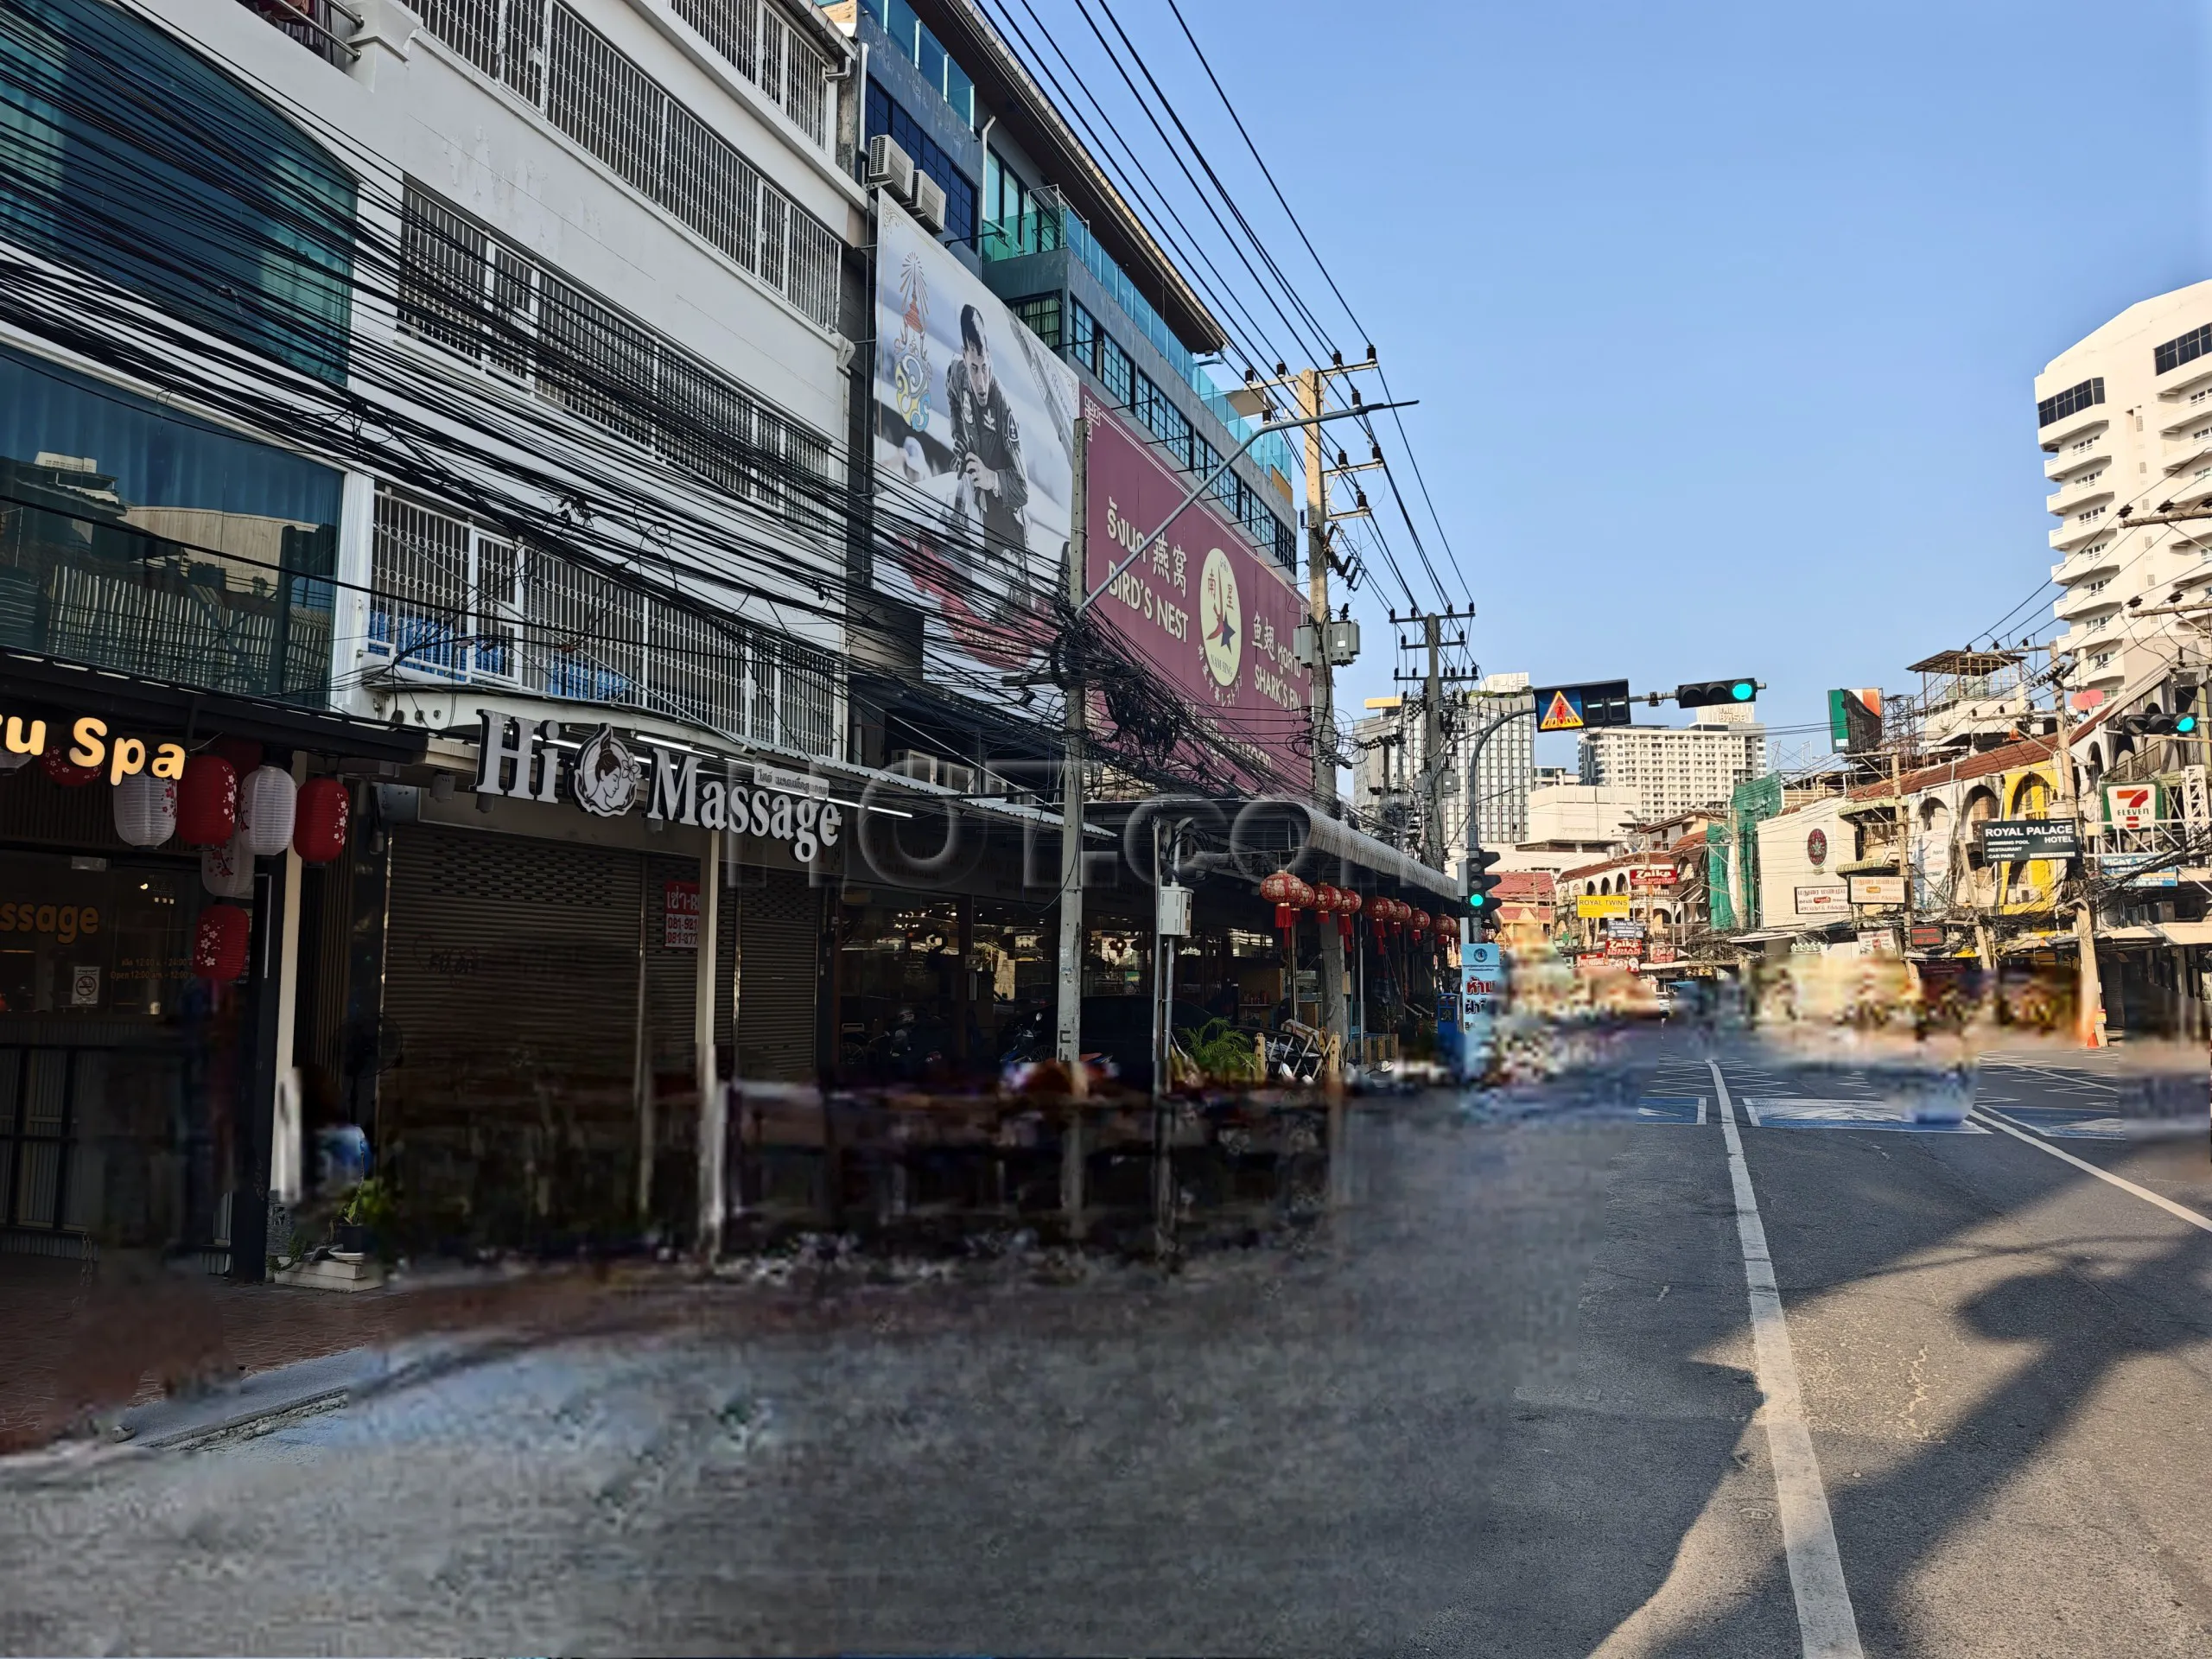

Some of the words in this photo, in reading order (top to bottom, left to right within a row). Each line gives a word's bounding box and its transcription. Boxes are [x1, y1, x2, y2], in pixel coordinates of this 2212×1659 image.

[1109, 559, 1153, 620] BIRD'S
[1157, 594, 1189, 643] NEST
[1211, 654, 1223, 670] NAM
[1223, 662, 1233, 677] SING
[1255, 664, 1287, 709] SHARK'S
[1289, 687, 1301, 717] FIN
[1719, 713, 1746, 722] BASE
[0, 714, 47, 756] u
[69, 717, 186, 786] Spa
[467, 709, 560, 804] Hi
[641, 747, 842, 863] Massage
[1985, 827, 2024, 837] ROYAL
[2026, 825, 2074, 836] PALACE
[1636, 869, 1672, 879] Zaika
[0, 902, 99, 944] ssage
